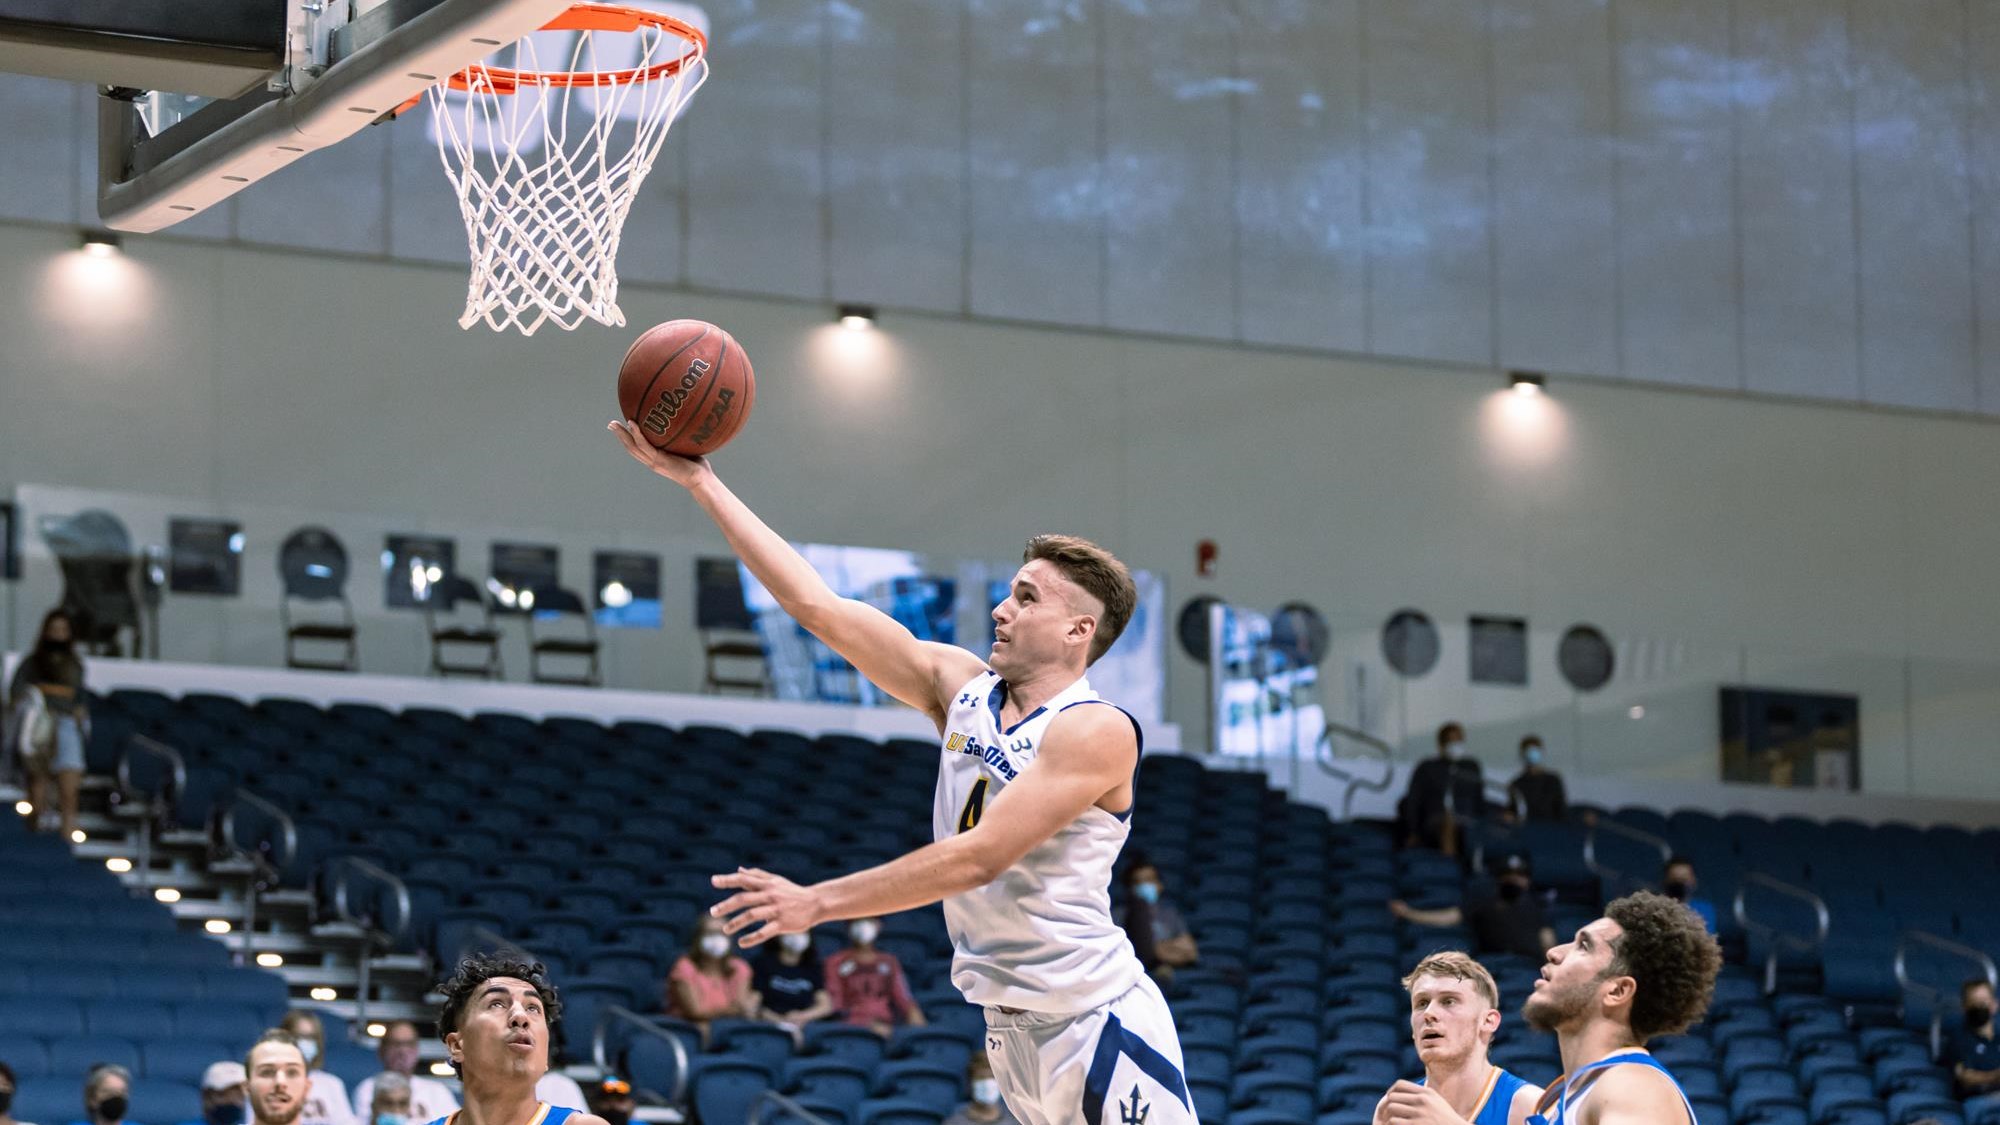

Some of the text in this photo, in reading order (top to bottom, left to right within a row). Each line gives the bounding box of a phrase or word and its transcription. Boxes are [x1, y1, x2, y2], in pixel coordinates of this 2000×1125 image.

[643, 358, 711, 436] Wilson
[691, 387, 736, 445] NCAA
[984, 745, 1018, 781] Dieg
